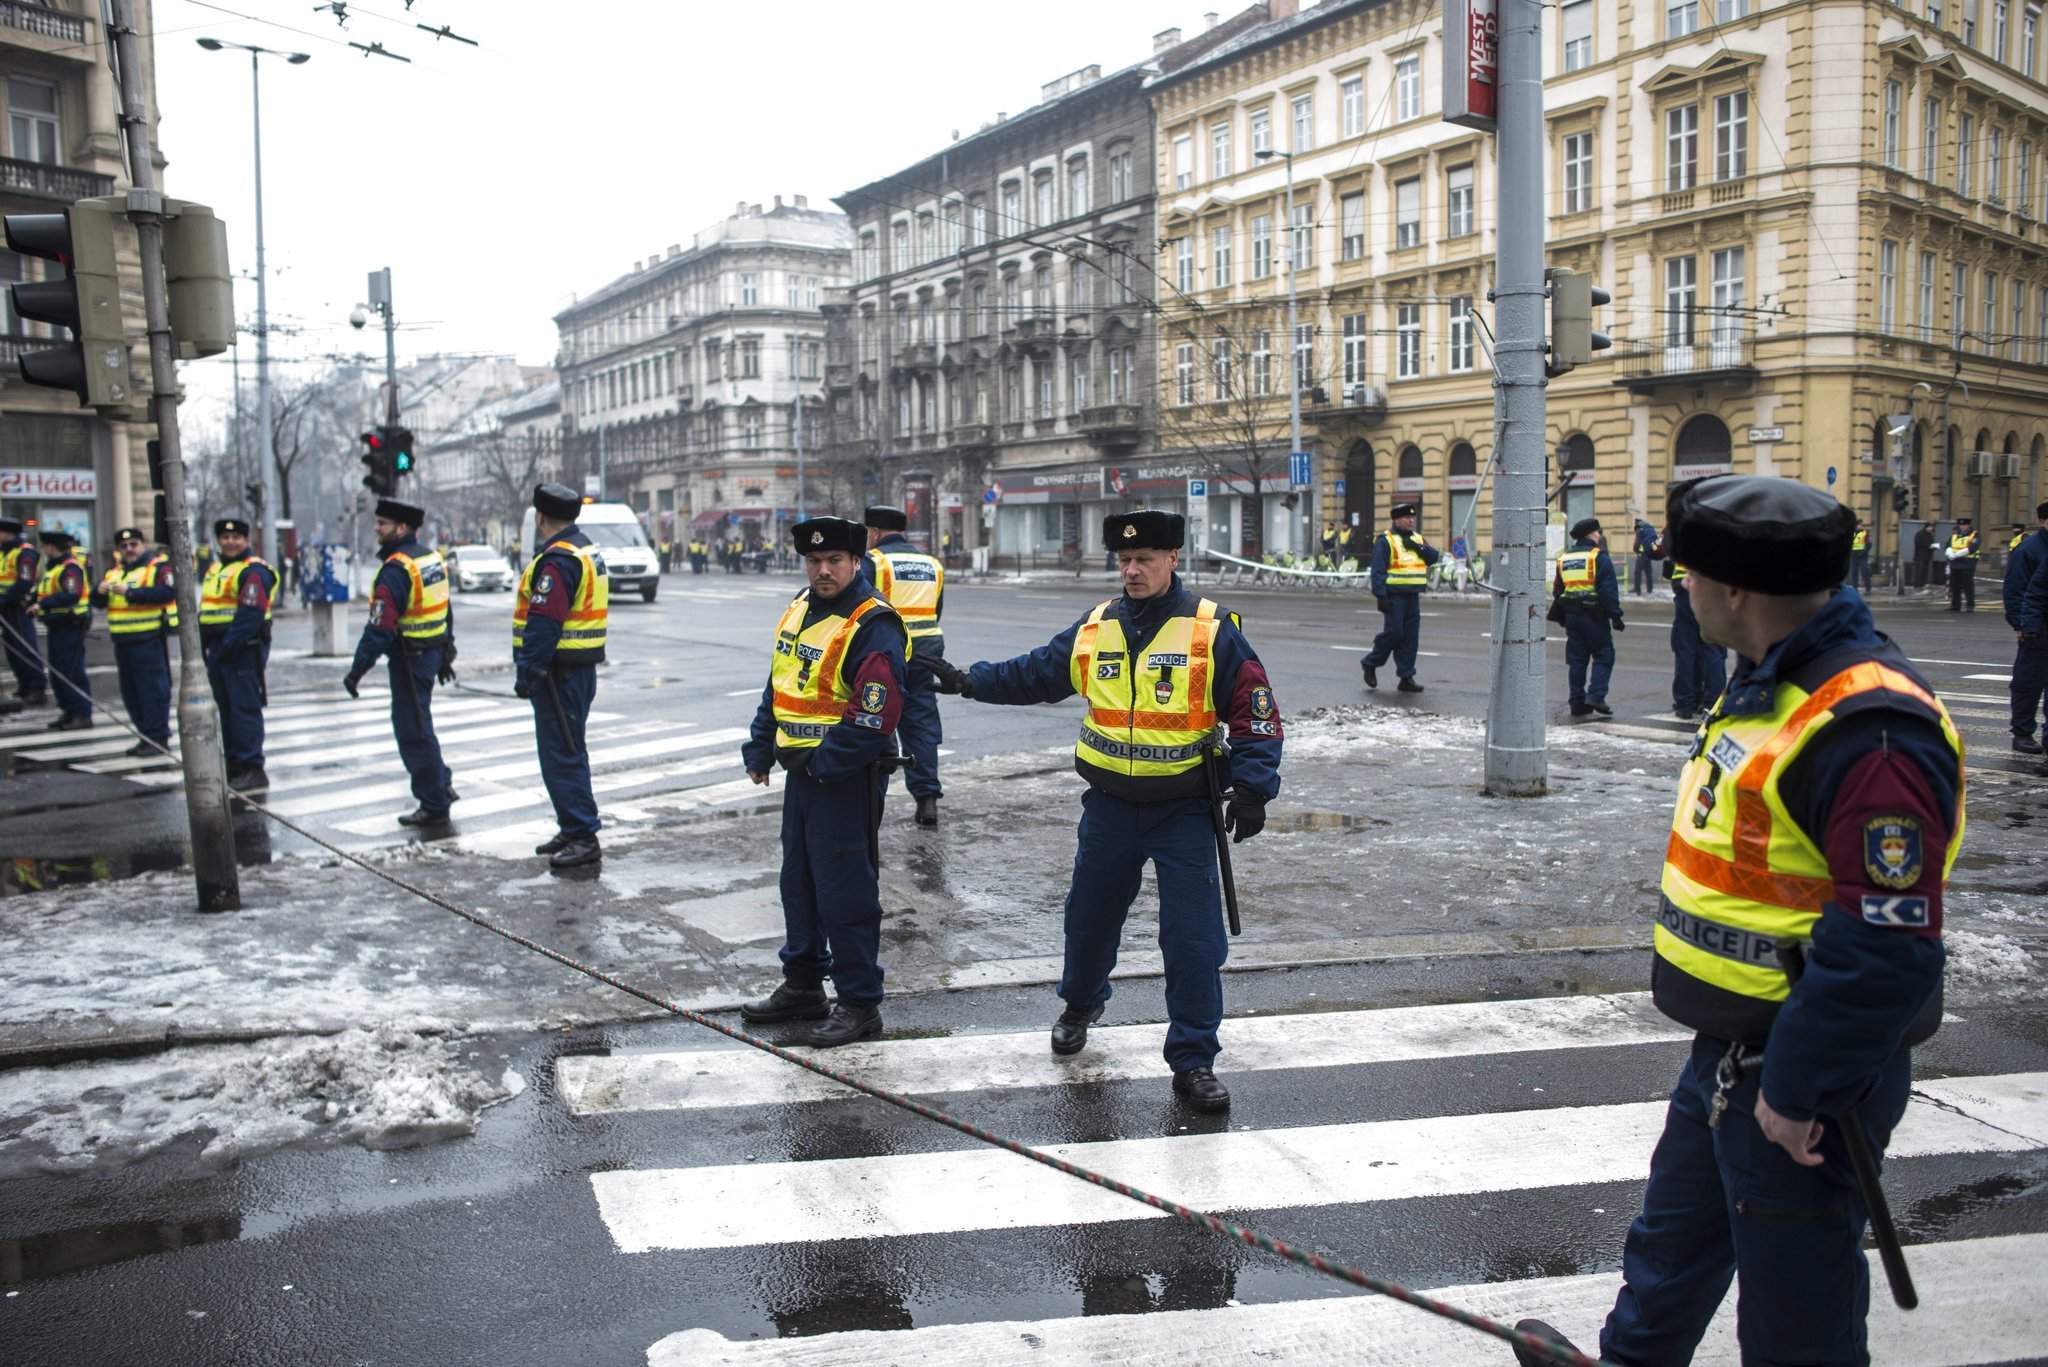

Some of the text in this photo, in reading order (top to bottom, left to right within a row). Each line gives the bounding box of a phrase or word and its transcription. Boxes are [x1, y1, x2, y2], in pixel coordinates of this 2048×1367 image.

[1471, 8, 1491, 82] WEST
[1484, 17, 1497, 68] END
[25, 472, 94, 494] Háda
[1193, 484, 1203, 494] P
[799, 644, 823, 659] POLICE
[1148, 655, 1187, 666] POLICE
[1130, 747, 1187, 760] POLICE
[1662, 902, 1738, 954] POLICE
